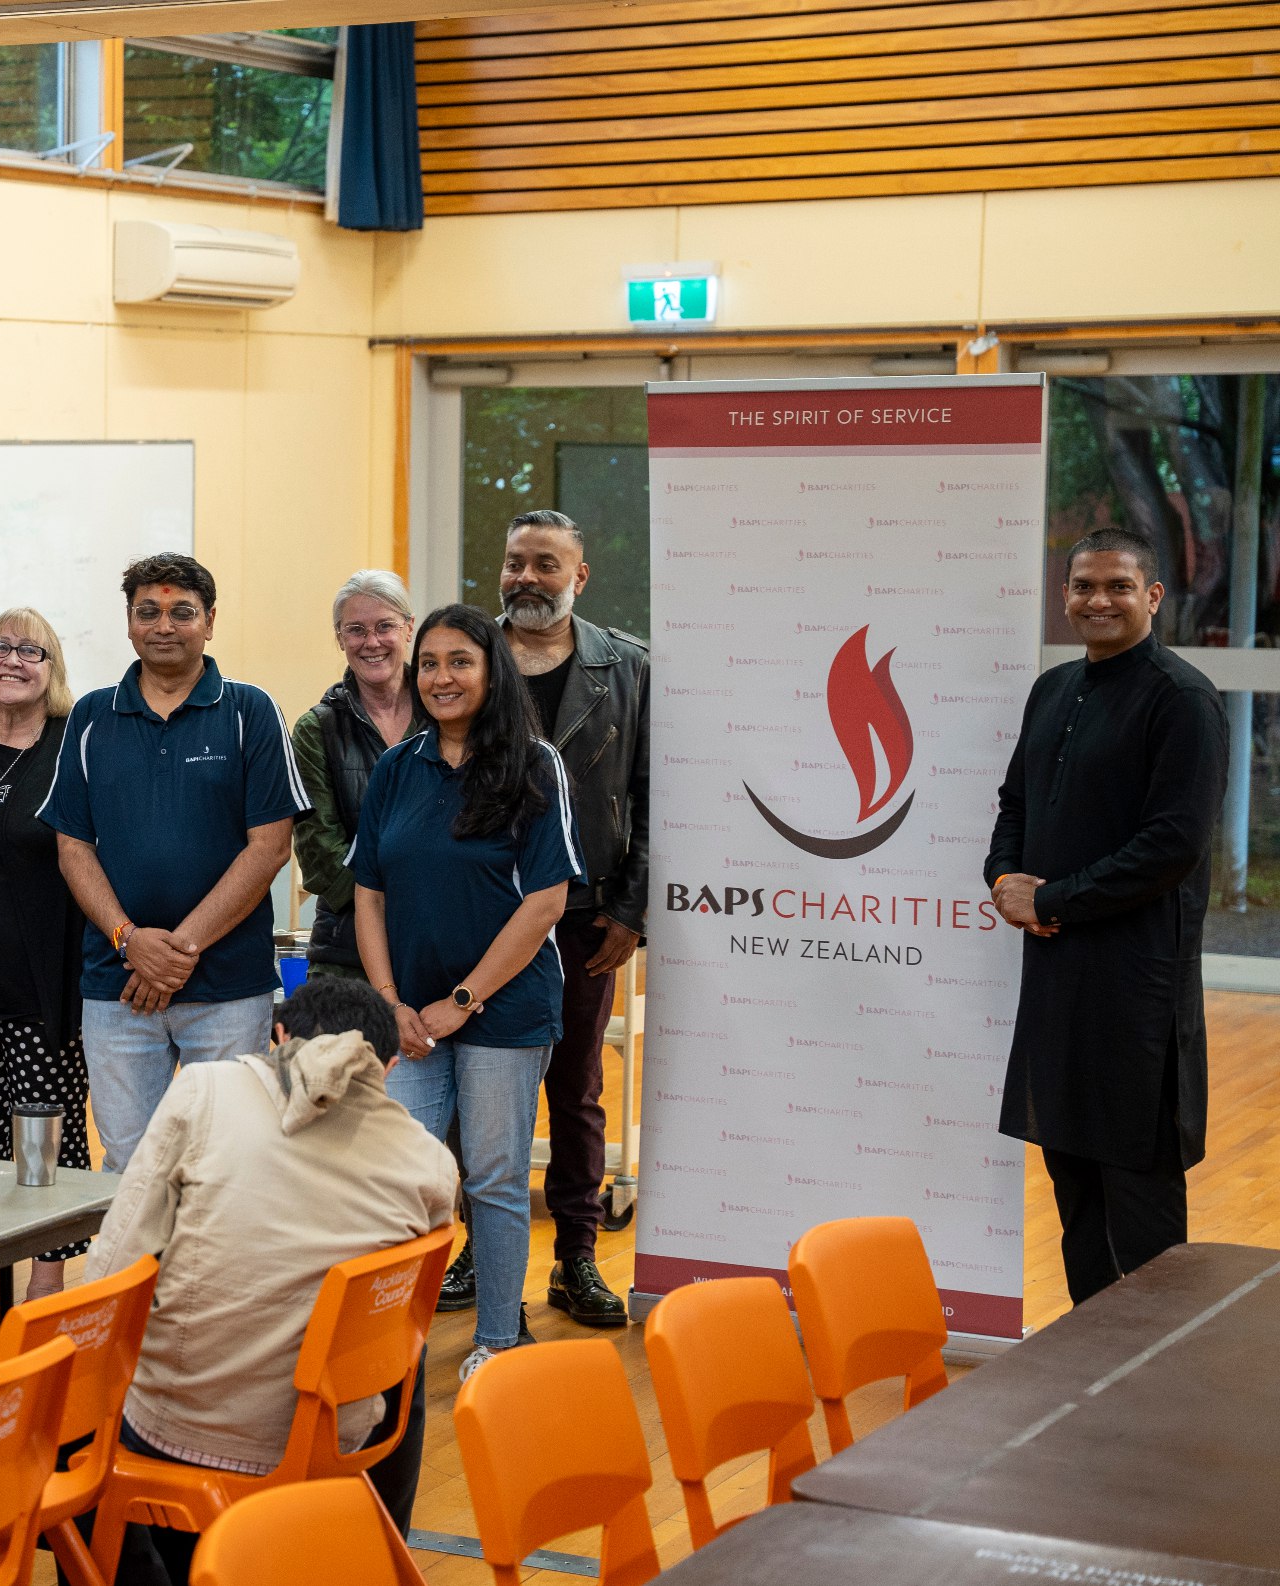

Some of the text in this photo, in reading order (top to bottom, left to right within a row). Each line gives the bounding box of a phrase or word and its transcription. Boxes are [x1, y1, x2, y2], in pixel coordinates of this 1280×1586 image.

[729, 408, 952, 426] THE SPIRIT OF SERVICE
[730, 935, 923, 966] NEW ZEALAND
